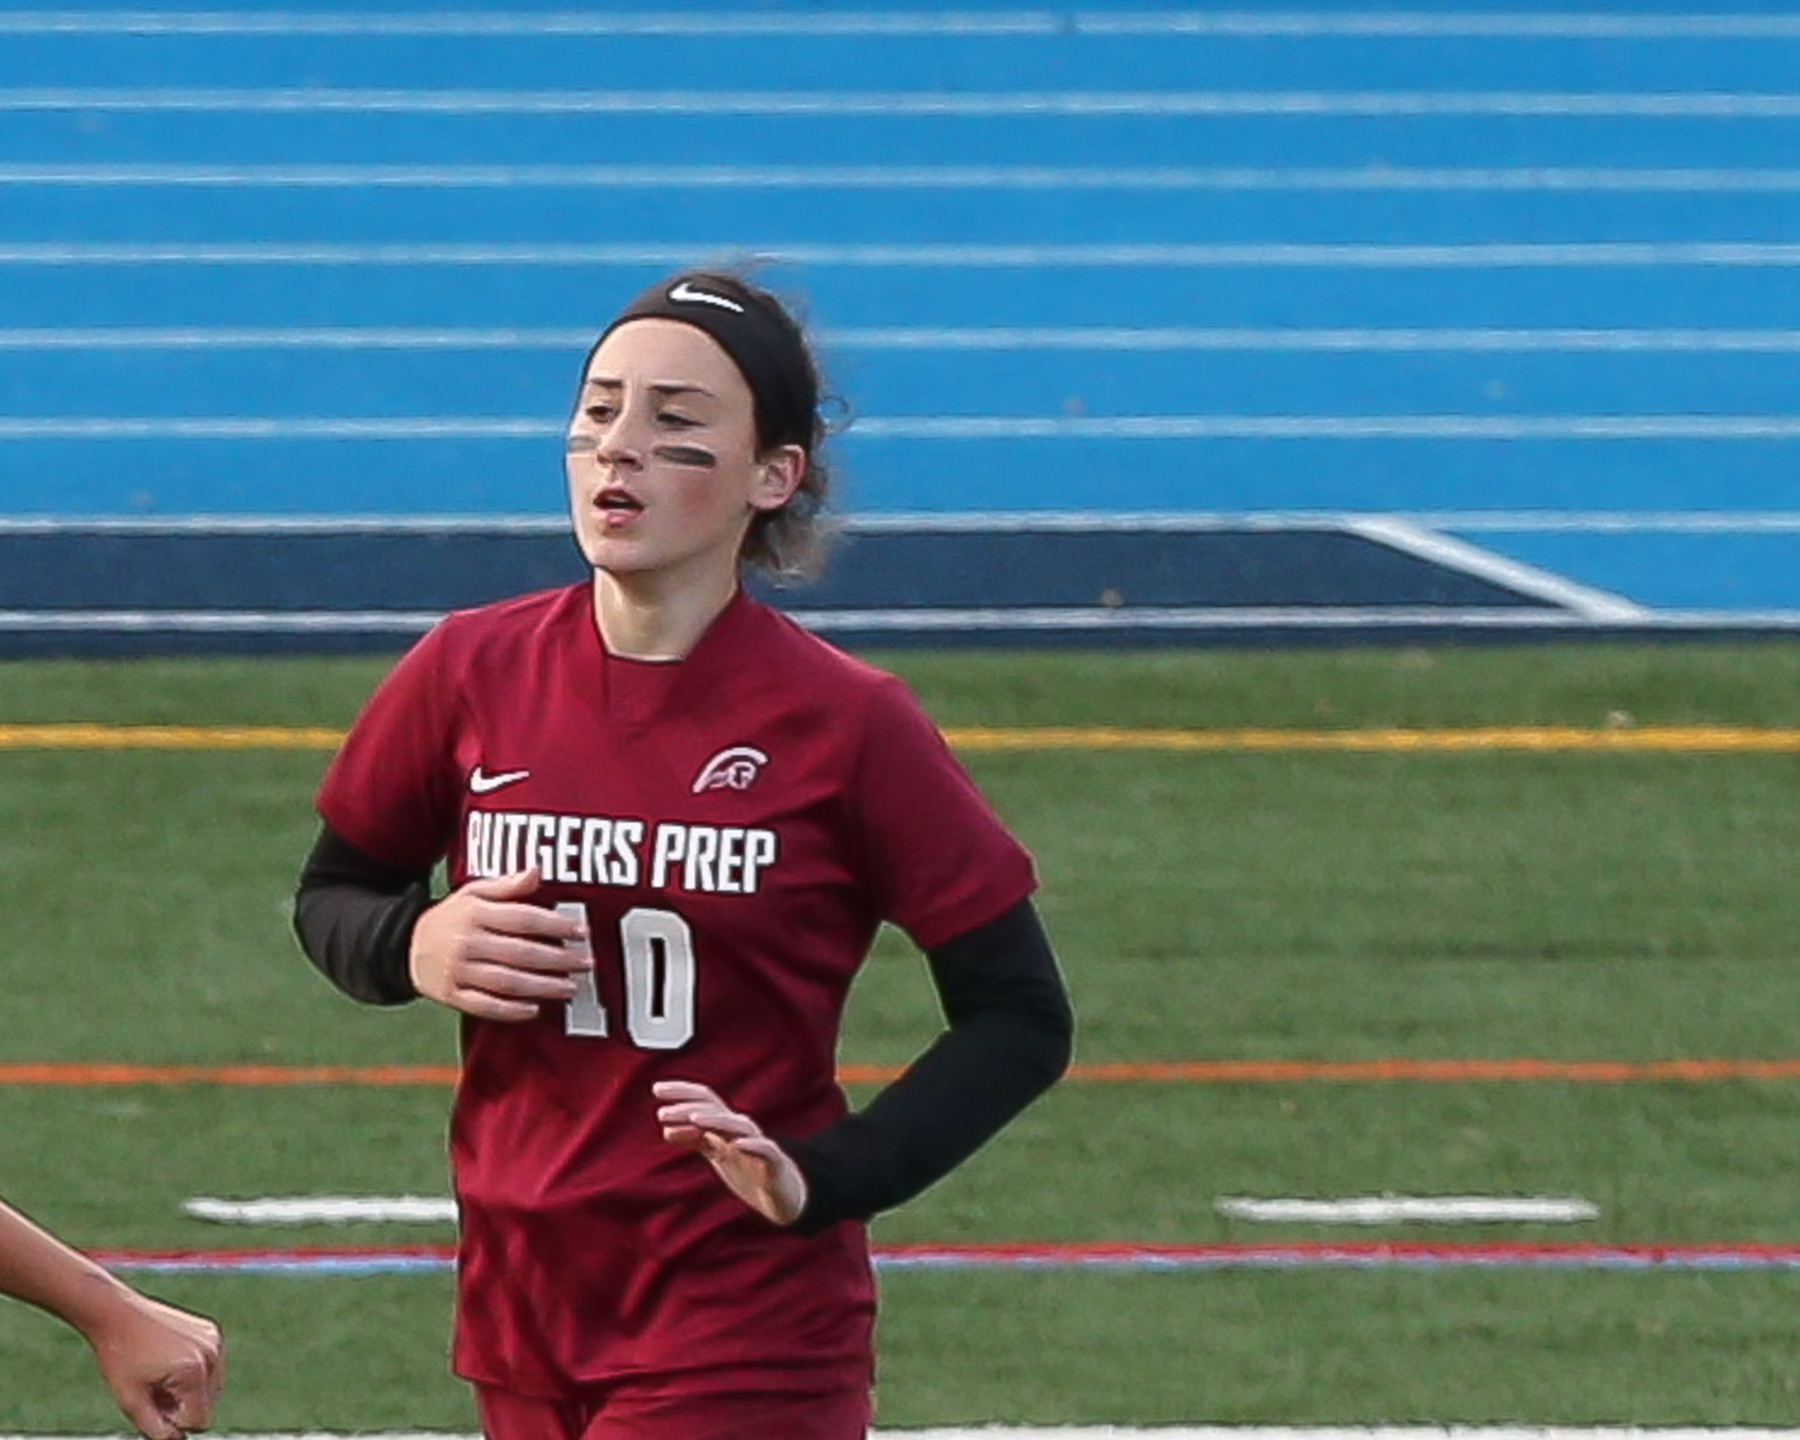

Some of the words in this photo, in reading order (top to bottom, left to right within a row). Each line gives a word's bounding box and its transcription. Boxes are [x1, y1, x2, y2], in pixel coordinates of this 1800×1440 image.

[466, 810, 644, 887] RUTGERS
[651, 823, 776, 894] PREP
[554, 901, 696, 1050] 10
